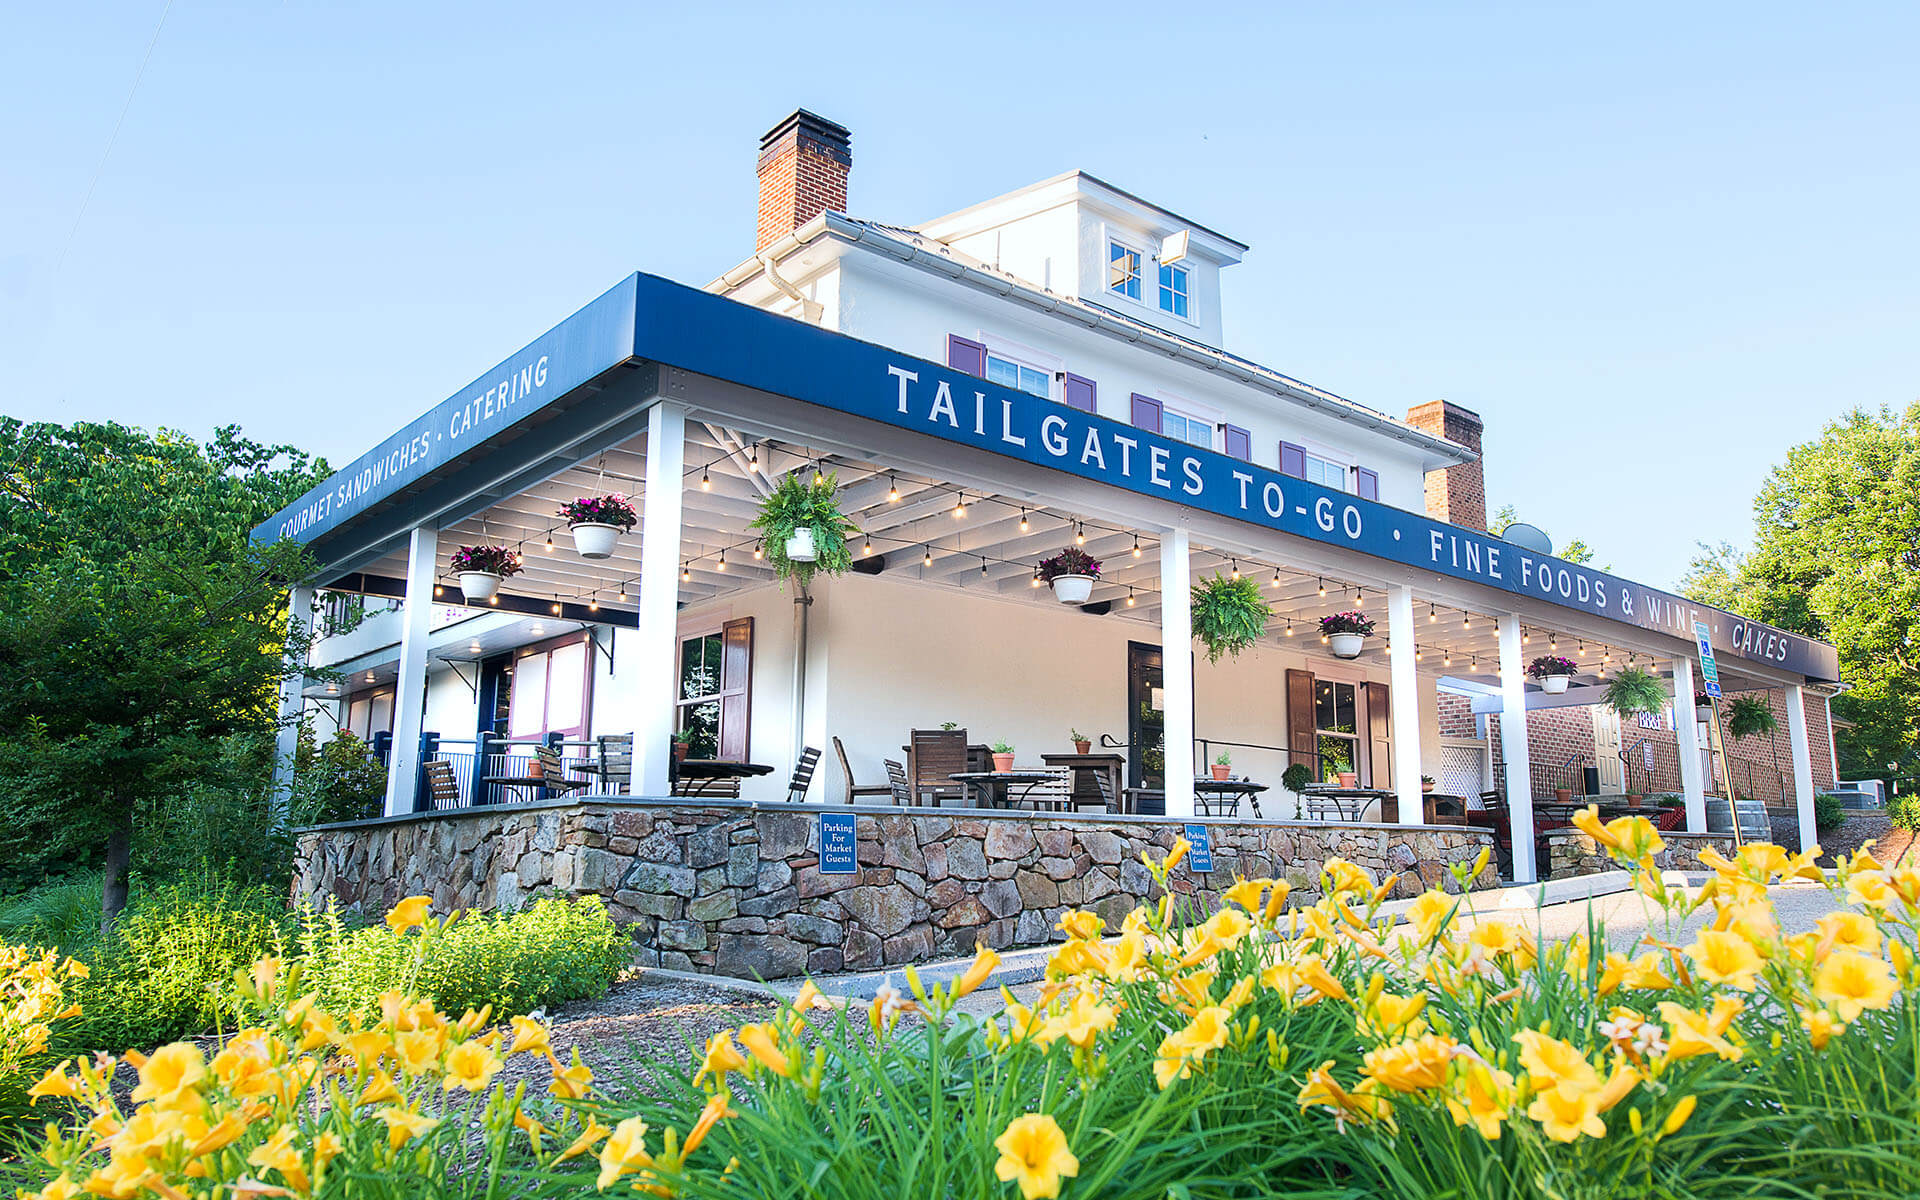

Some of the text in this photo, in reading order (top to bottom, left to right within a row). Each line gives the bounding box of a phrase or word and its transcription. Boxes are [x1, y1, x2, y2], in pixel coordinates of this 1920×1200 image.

[336, 431, 430, 508] SANDWICHES
[450, 355, 549, 439] CATERING
[888, 364, 1204, 495] TAILGATES
[1233, 470, 1362, 540] TO-GO
[1429, 529, 1502, 580] FINE
[1520, 557, 1607, 608] FOODS
[1622, 588, 1634, 616] &
[1732, 624, 1787, 661] CAKES
[824, 822, 853, 832] Parking
[832, 833, 845, 842] For
[825, 843, 852, 852] Market
[825, 854, 851, 863] Guests
